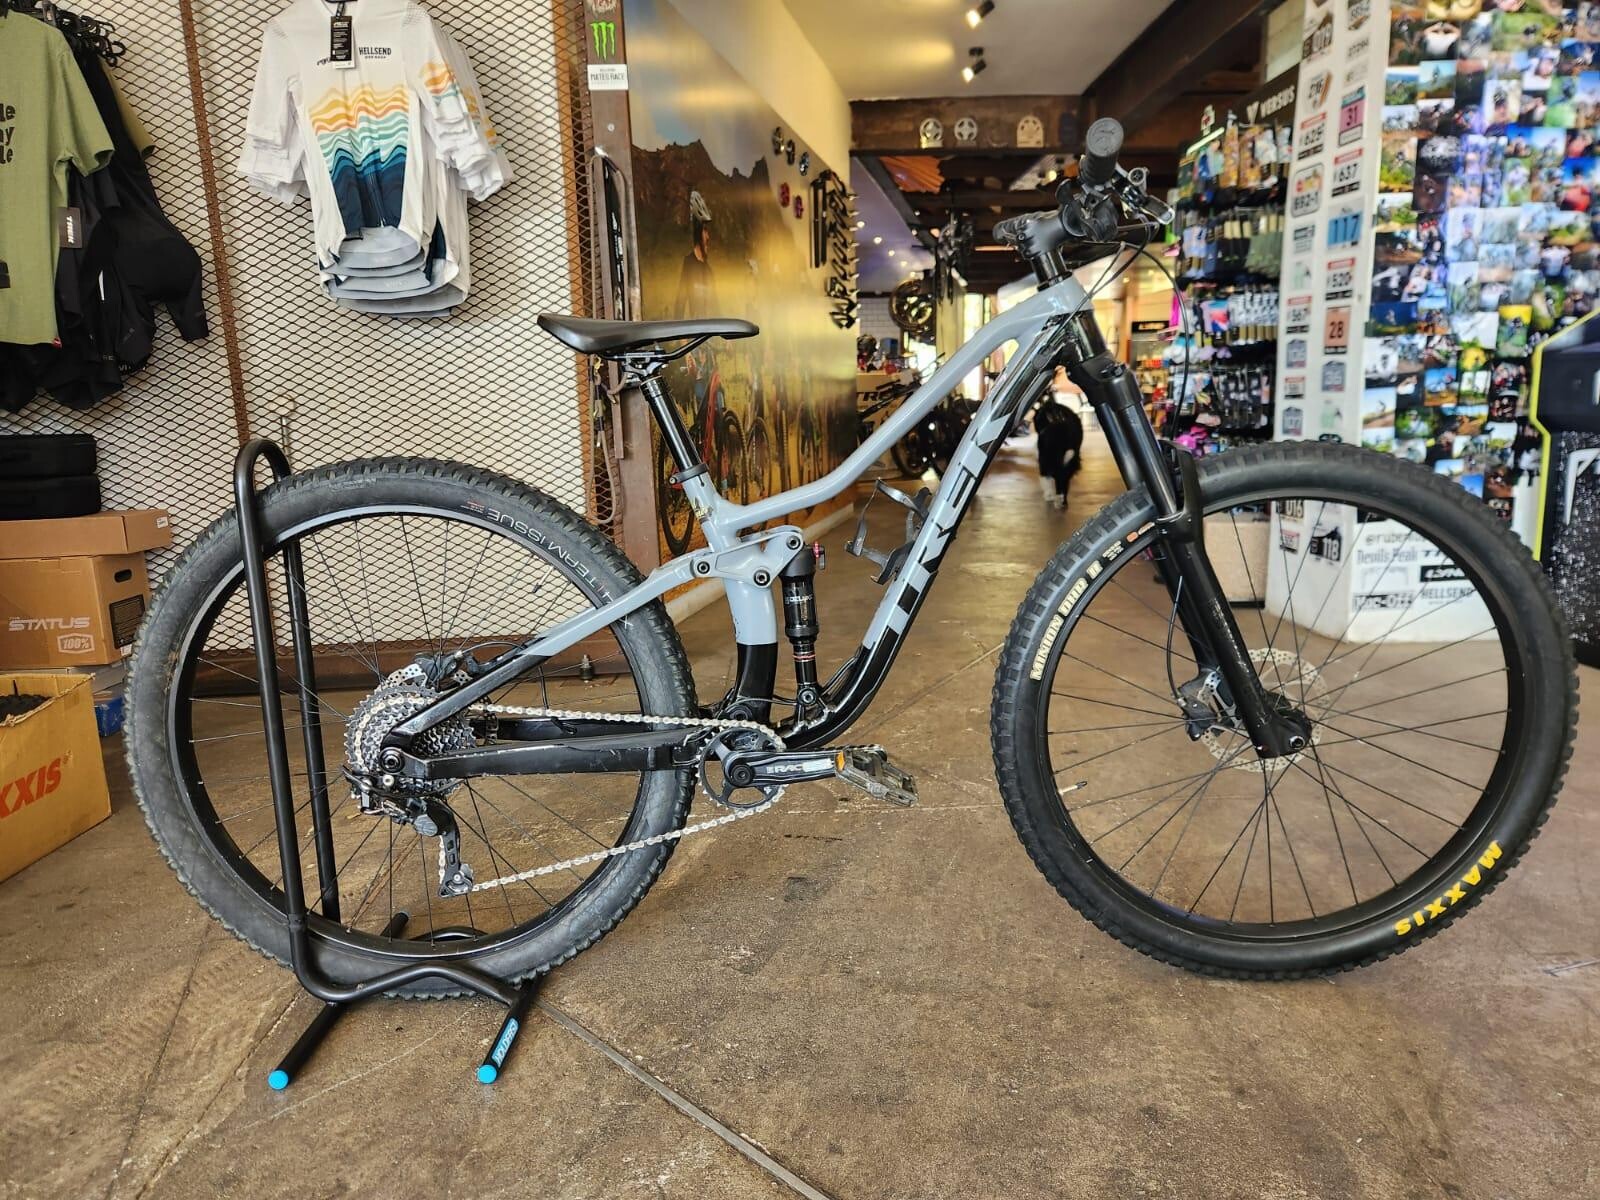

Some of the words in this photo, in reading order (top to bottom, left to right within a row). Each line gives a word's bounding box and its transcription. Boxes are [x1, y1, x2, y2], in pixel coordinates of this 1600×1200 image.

[359, 46, 392, 56] HELLSEND
[1260, 85, 1295, 118] VERSUS
[1345, 105, 1359, 128] 31
[1332, 213, 1361, 243] 117
[1329, 320, 1345, 339] 28
[486, 508, 546, 546] ISSUE
[862, 400, 1013, 650] TREK
[1322, 537, 1340, 561] 118
[547, 540, 597, 589] TEAM
[8, 616, 91, 632] STATUS
[62, 637, 91, 650] 100%
[1029, 613, 1065, 681] MINION
[1393, 840, 1504, 936] MAXXIS
